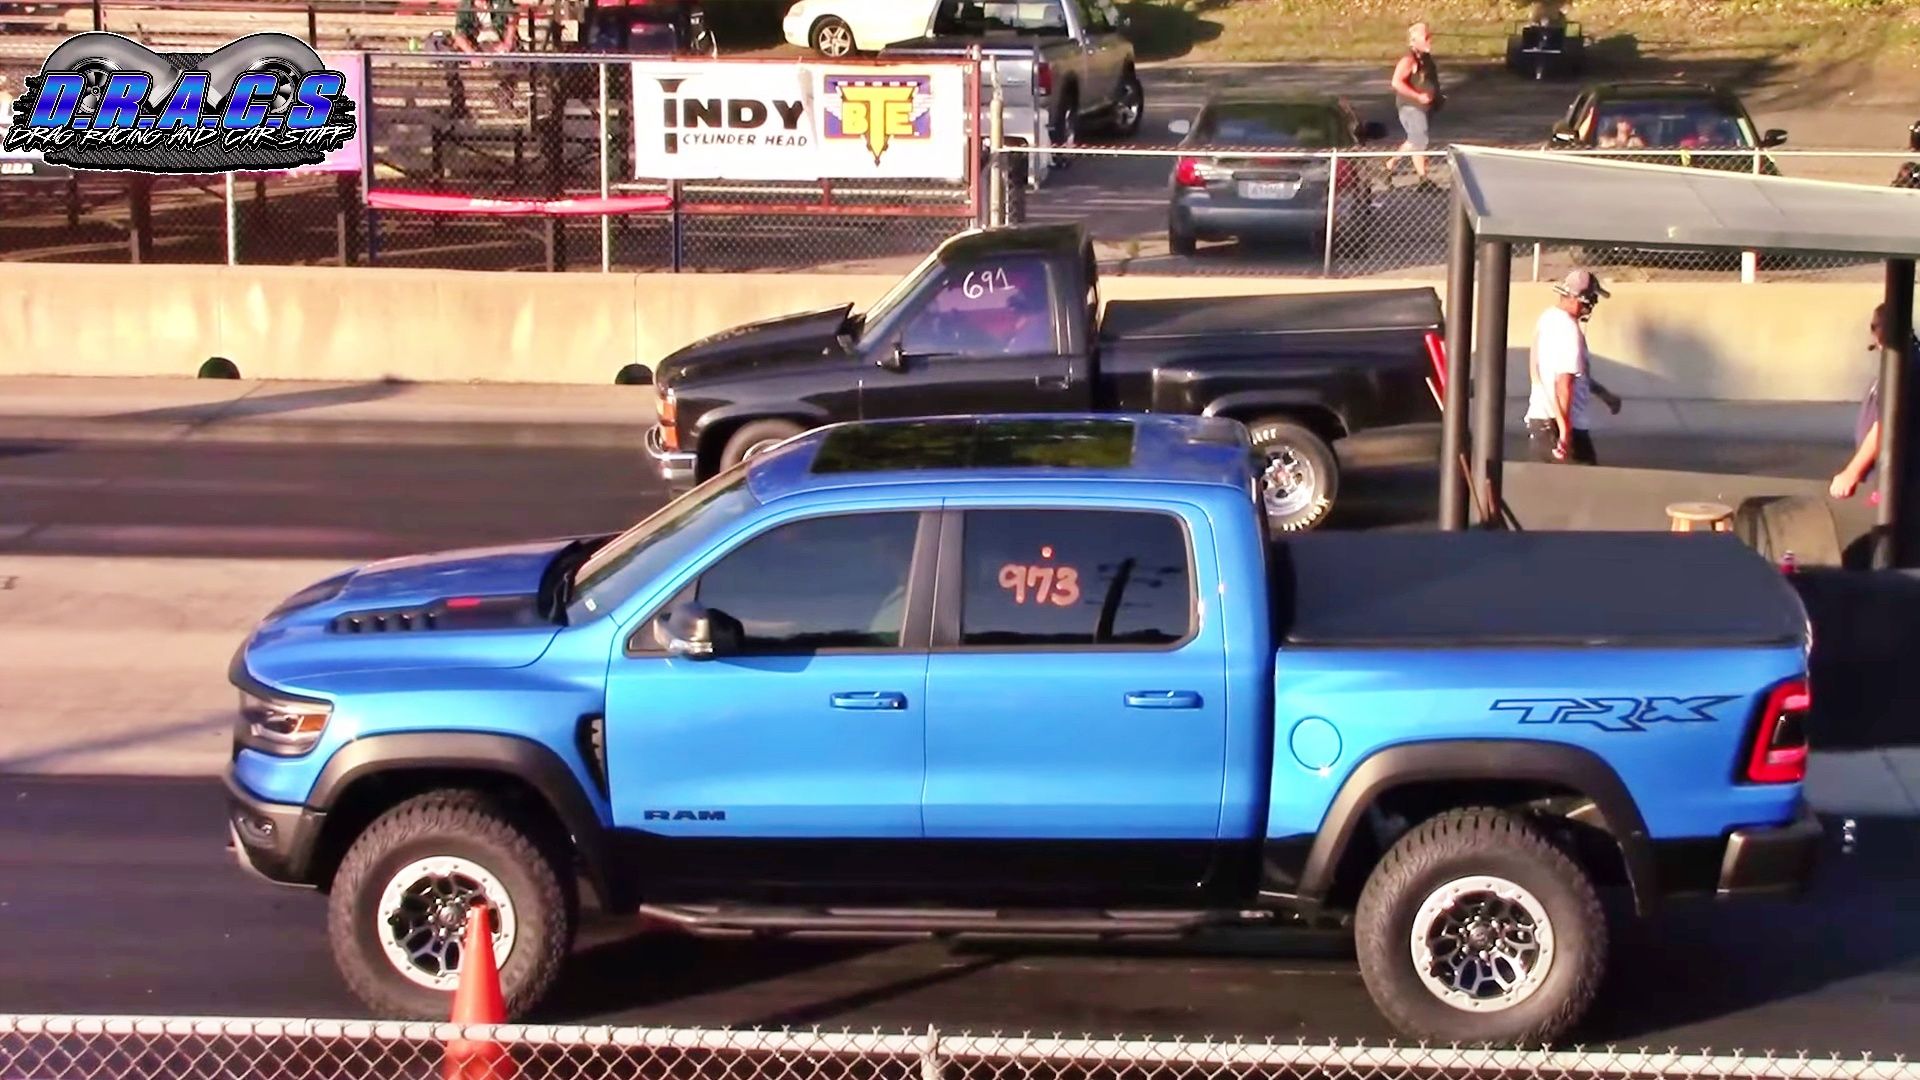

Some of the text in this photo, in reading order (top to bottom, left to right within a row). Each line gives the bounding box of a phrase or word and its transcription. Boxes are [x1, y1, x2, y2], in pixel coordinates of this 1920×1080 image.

[656, 78, 804, 153] INDY
[841, 86, 915, 166] BTE
[682, 133, 808, 147] CYLINDER HEAD
[963, 267, 1016, 299] 691
[998, 563, 1081, 607] 973
[1489, 694, 1744, 732] TRX
[643, 809, 727, 821] RAM
